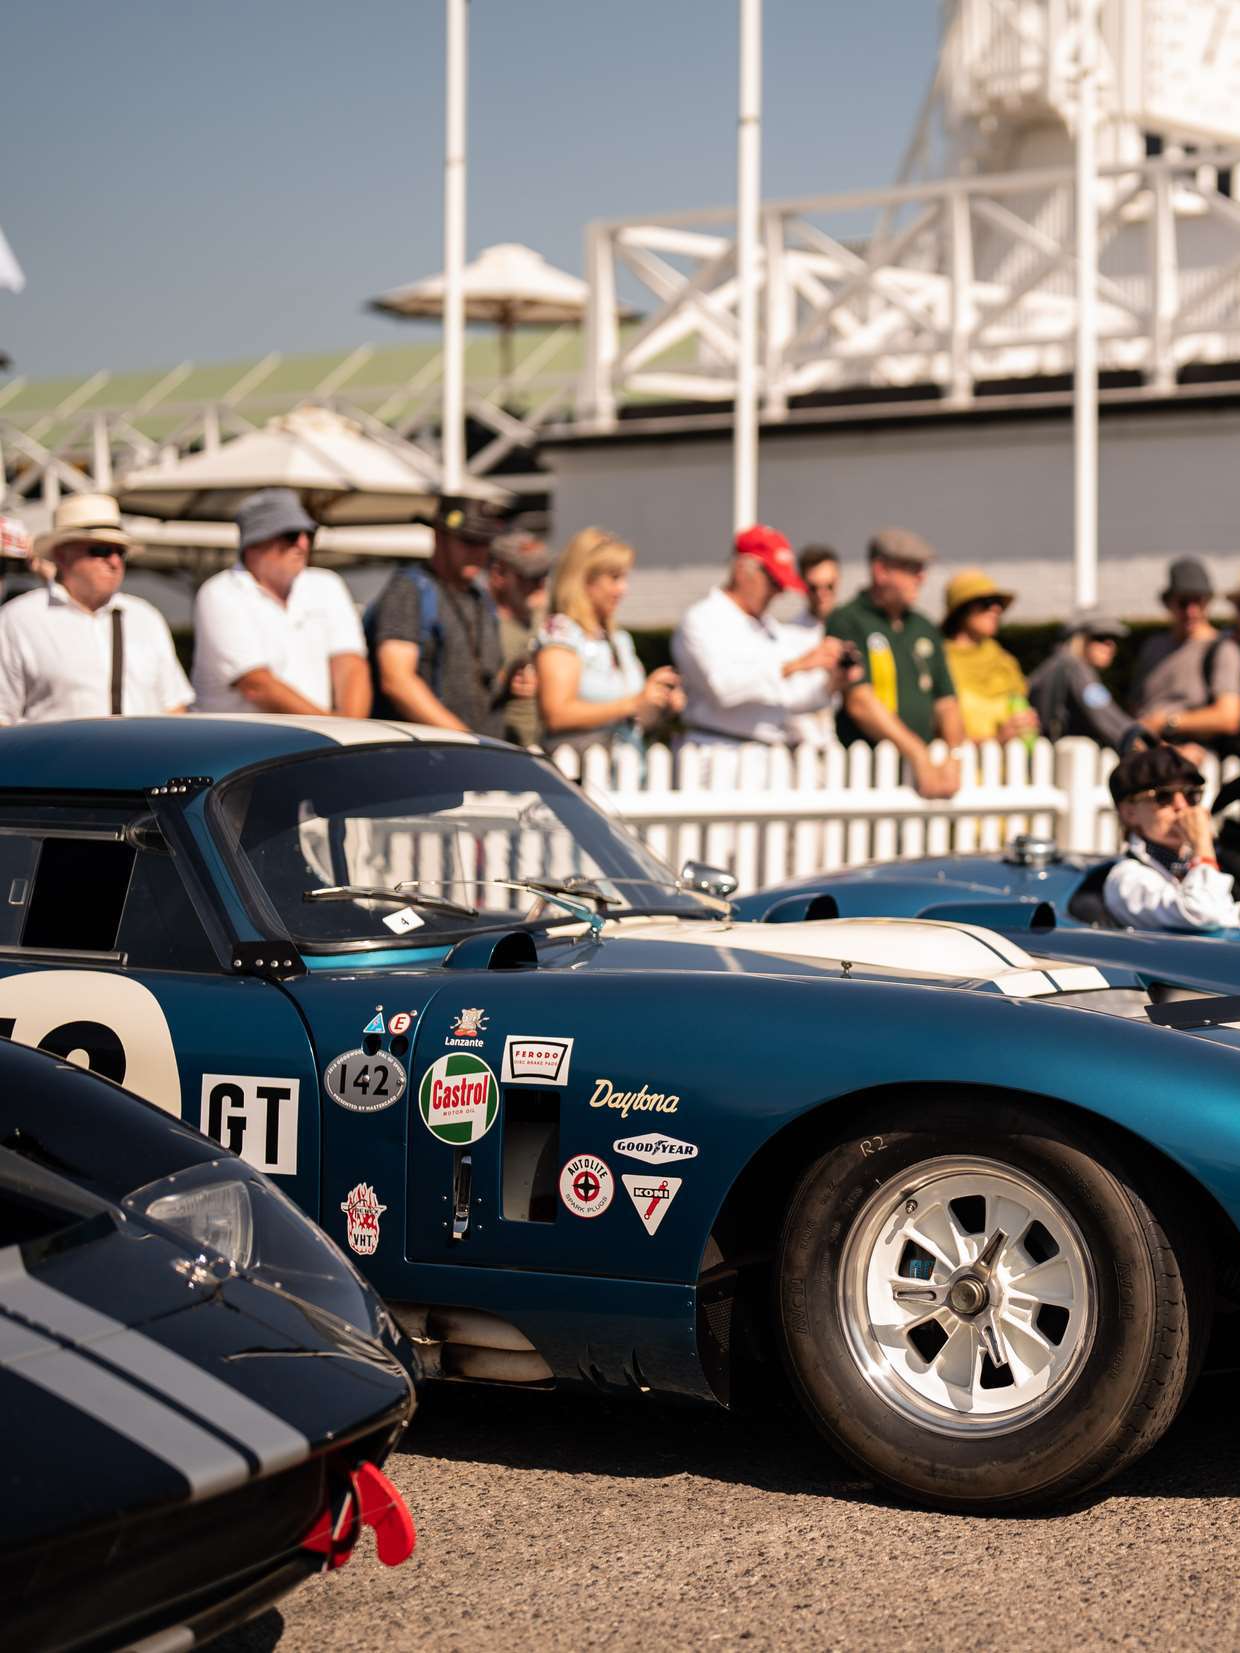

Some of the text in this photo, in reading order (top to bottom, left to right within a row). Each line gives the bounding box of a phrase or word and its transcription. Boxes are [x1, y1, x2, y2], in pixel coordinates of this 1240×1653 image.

[394, 1016, 406, 1031] E
[445, 1037, 484, 1048] Lanzante
[515, 1050, 559, 1059] FERODO
[340, 1064, 389, 1096] 142
[432, 1074, 488, 1110] Castrol
[589, 1079, 680, 1118] Daytona
[333, 1093, 358, 1111] PRESENTED
[366, 1095, 397, 1112] MASTERCARD
[208, 1082, 291, 1165] GT
[617, 1140, 694, 1155] GOODYEAR
[567, 1158, 608, 1179] AUTOLITE
[634, 1188, 669, 1198] KONI
[566, 1193, 608, 1213] SPARK PLUGS
[354, 1233, 372, 1247] VHT
